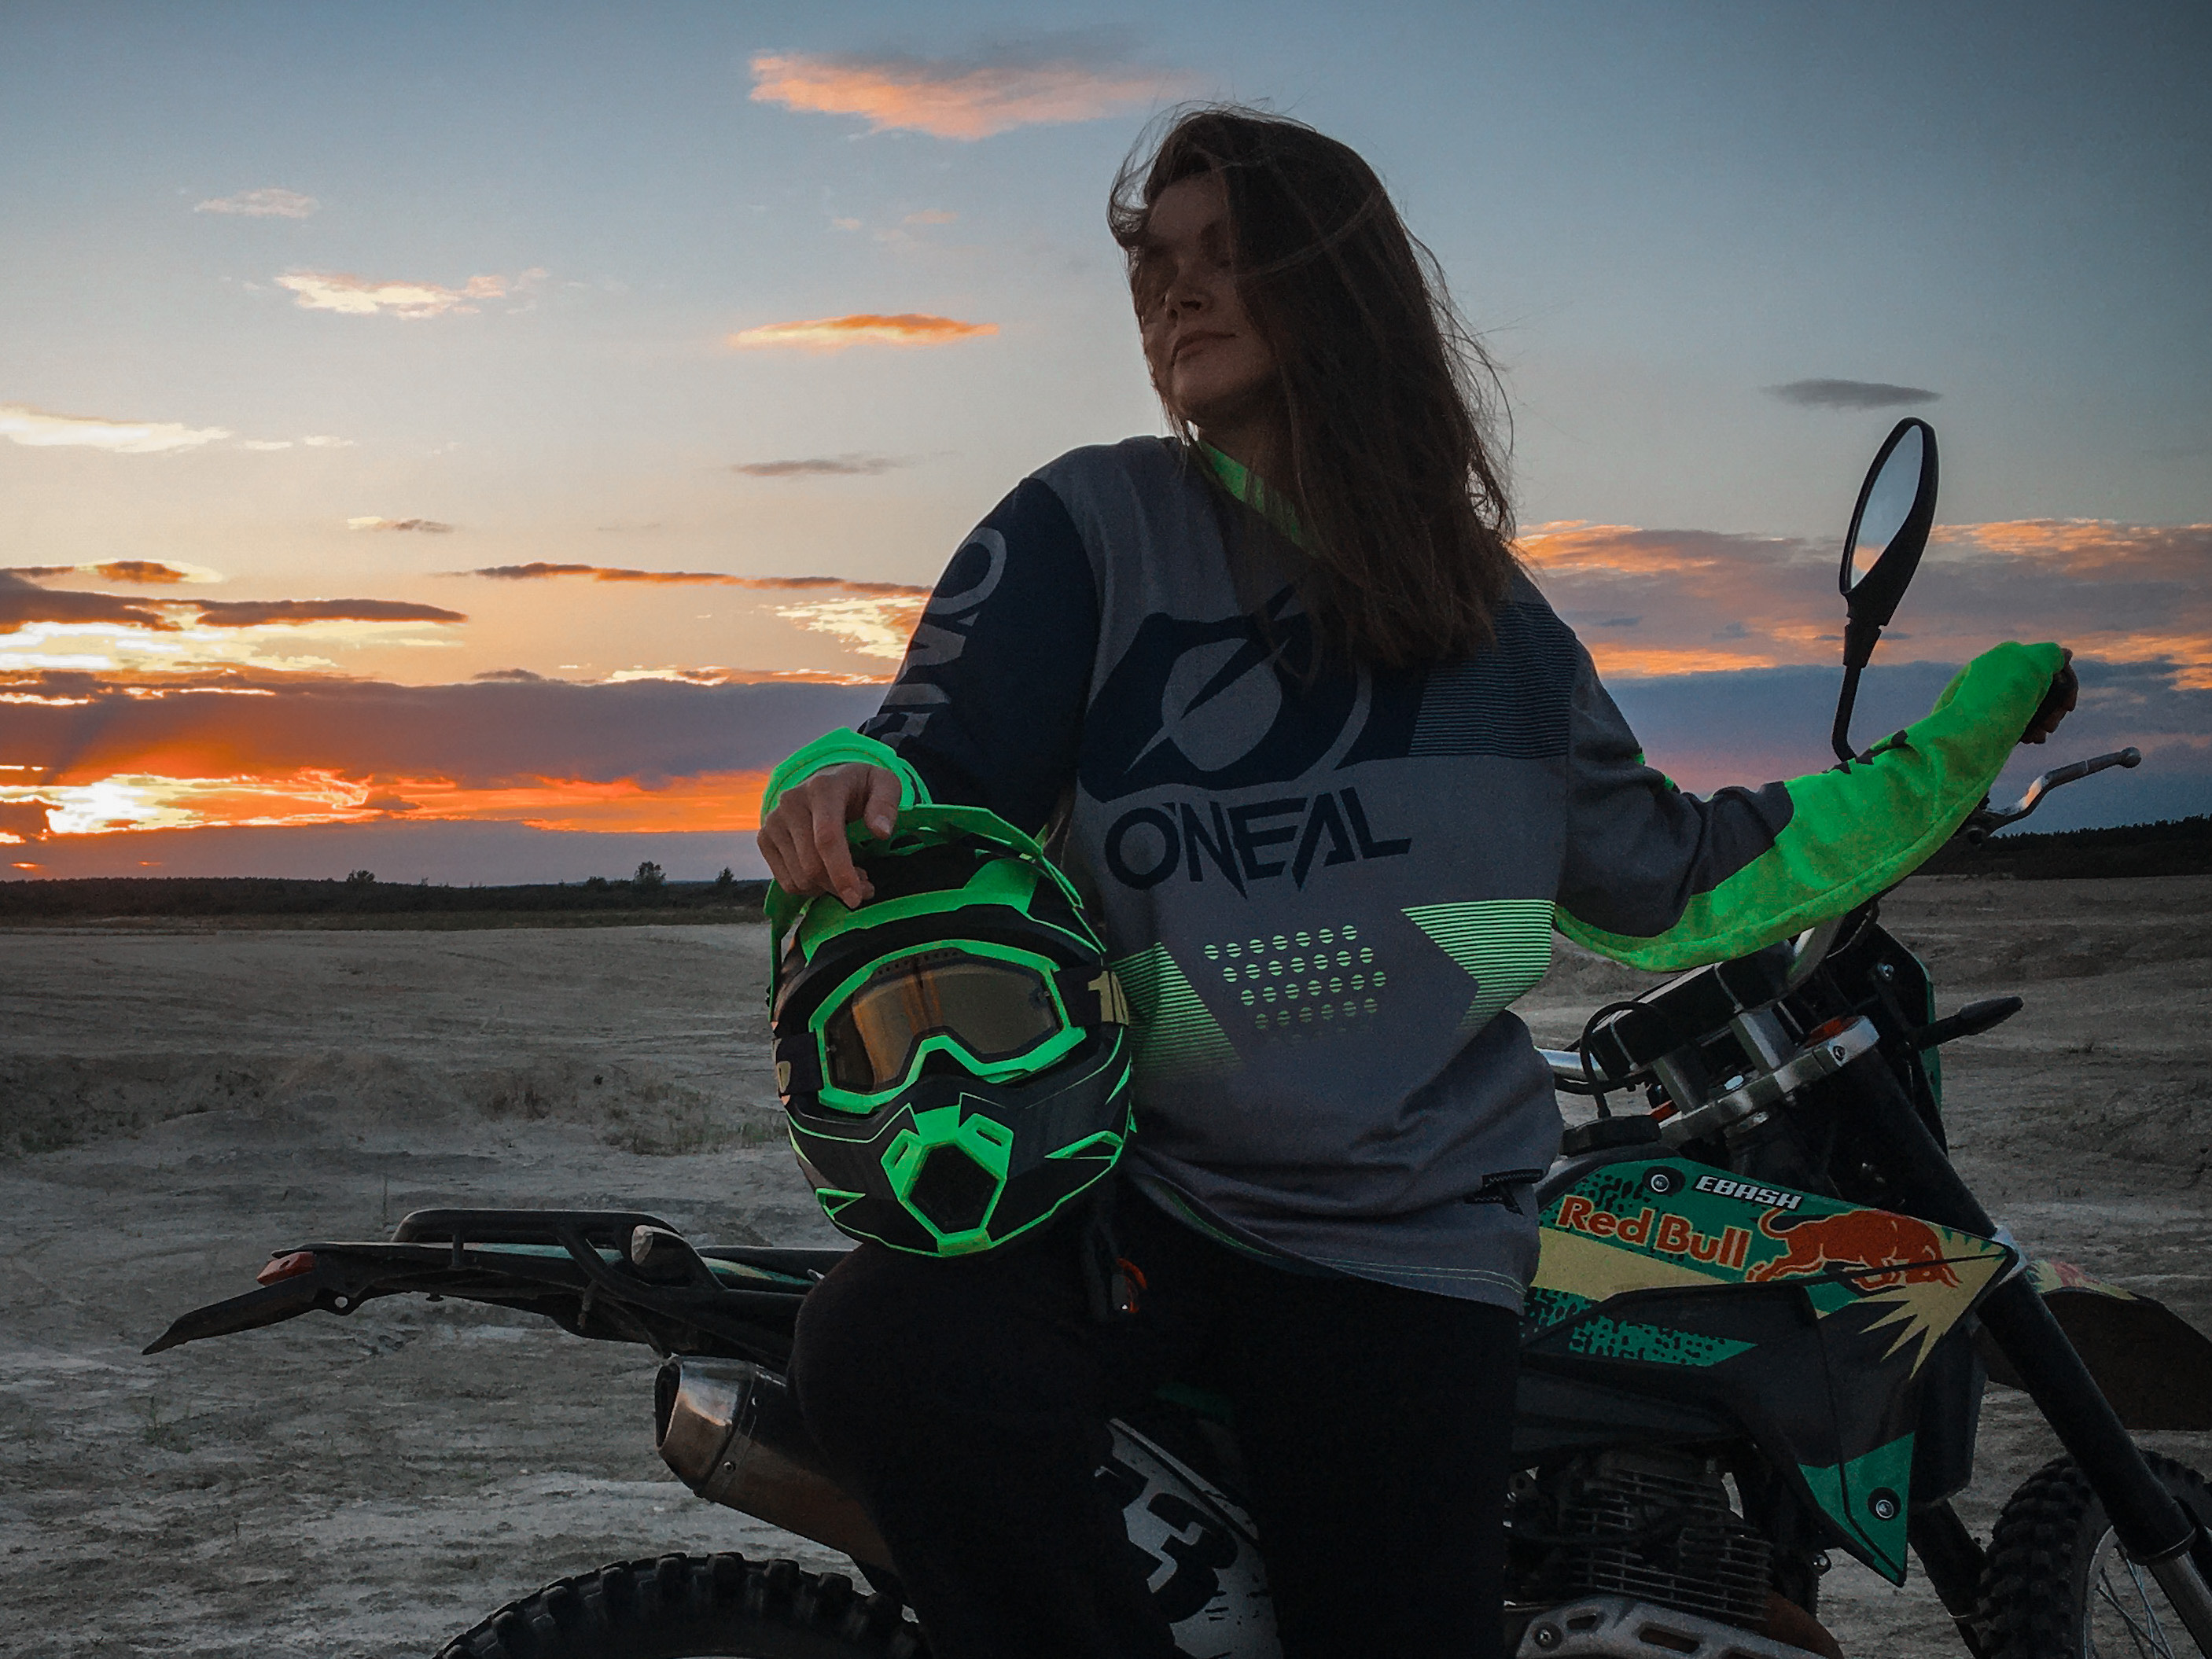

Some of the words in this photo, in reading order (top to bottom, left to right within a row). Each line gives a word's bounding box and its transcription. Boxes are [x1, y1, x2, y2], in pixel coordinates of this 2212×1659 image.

[1104, 786, 1412, 899] O'NEAL
[1695, 1175, 1802, 1210] EBASH
[1555, 1194, 1656, 1247] Red
[1653, 1213, 1753, 1271] Bull
